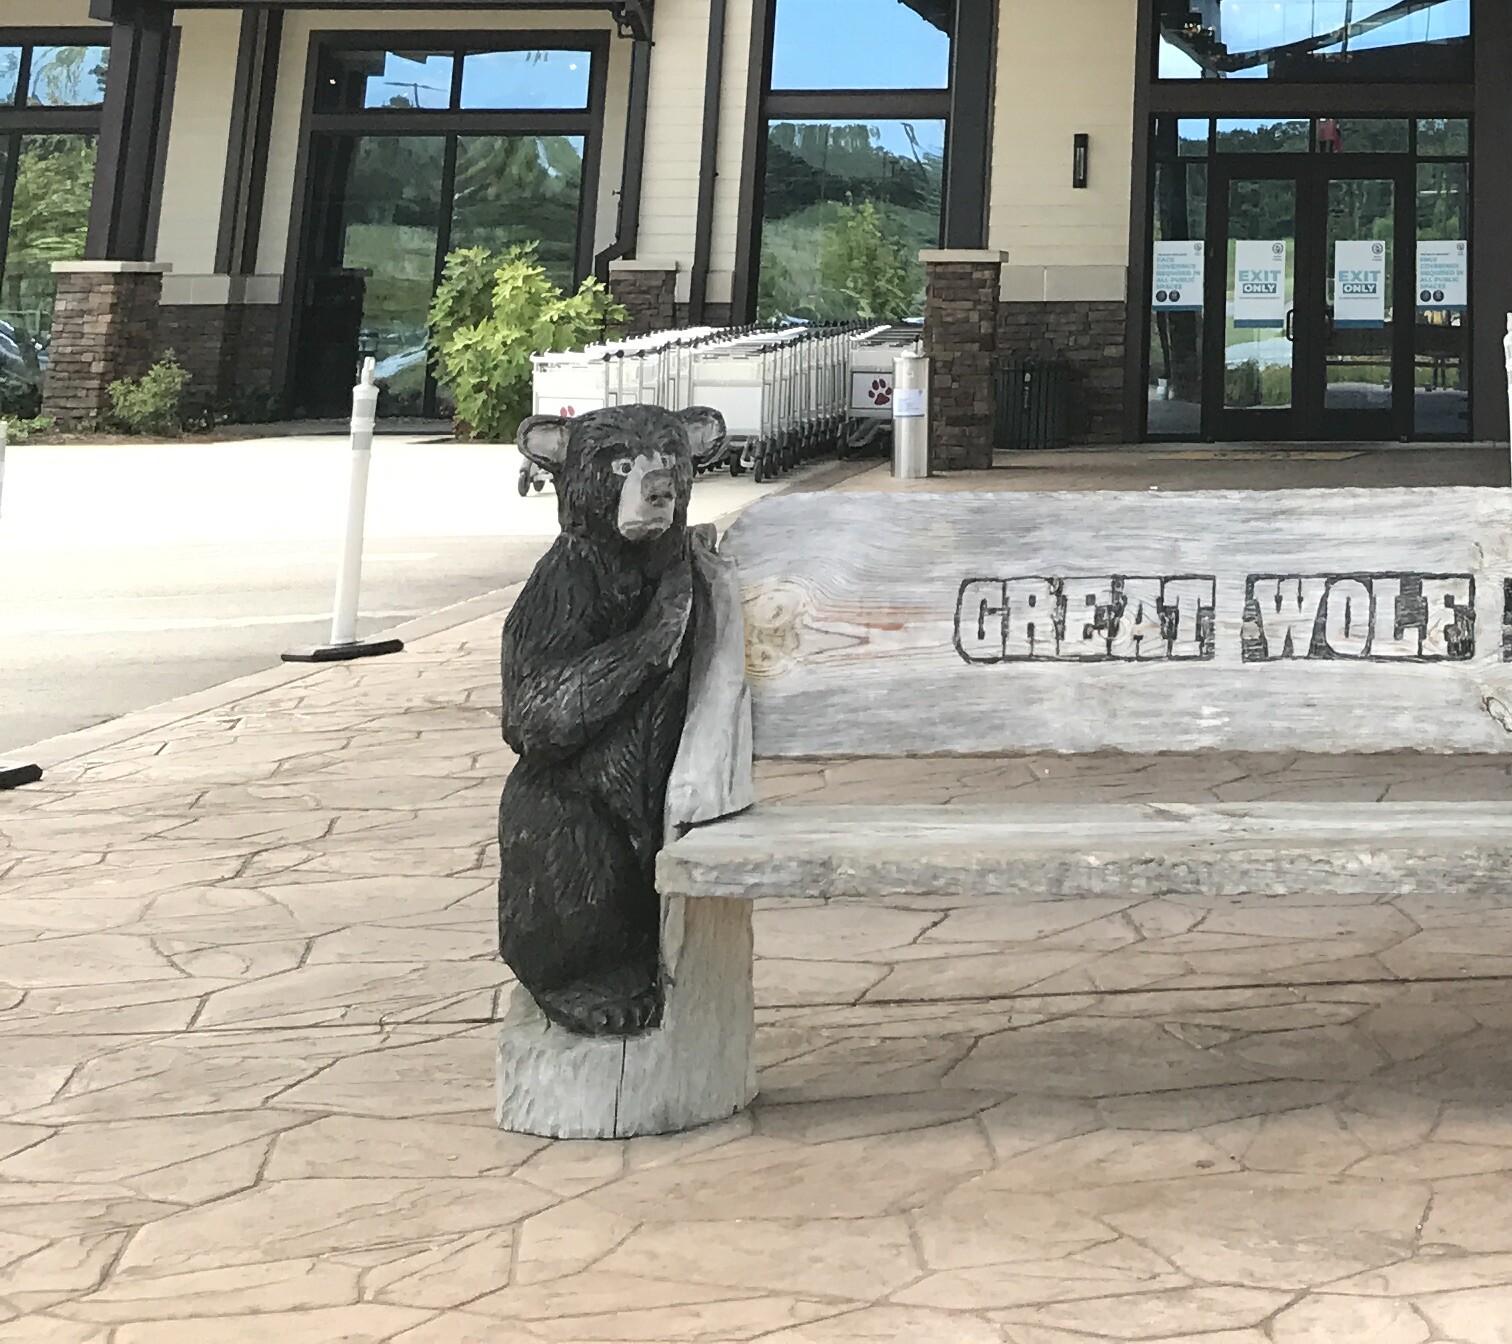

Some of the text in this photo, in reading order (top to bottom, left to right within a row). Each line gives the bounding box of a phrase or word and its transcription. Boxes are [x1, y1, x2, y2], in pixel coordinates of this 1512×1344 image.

[1238, 270, 1282, 282] EXIT
[1338, 270, 1382, 282] EXIT
[1243, 283, 1276, 293] ONLY
[1343, 283, 1376, 293] ONLY
[953, 575, 1216, 664] GREAT
[1243, 573, 1476, 662] WOLF
